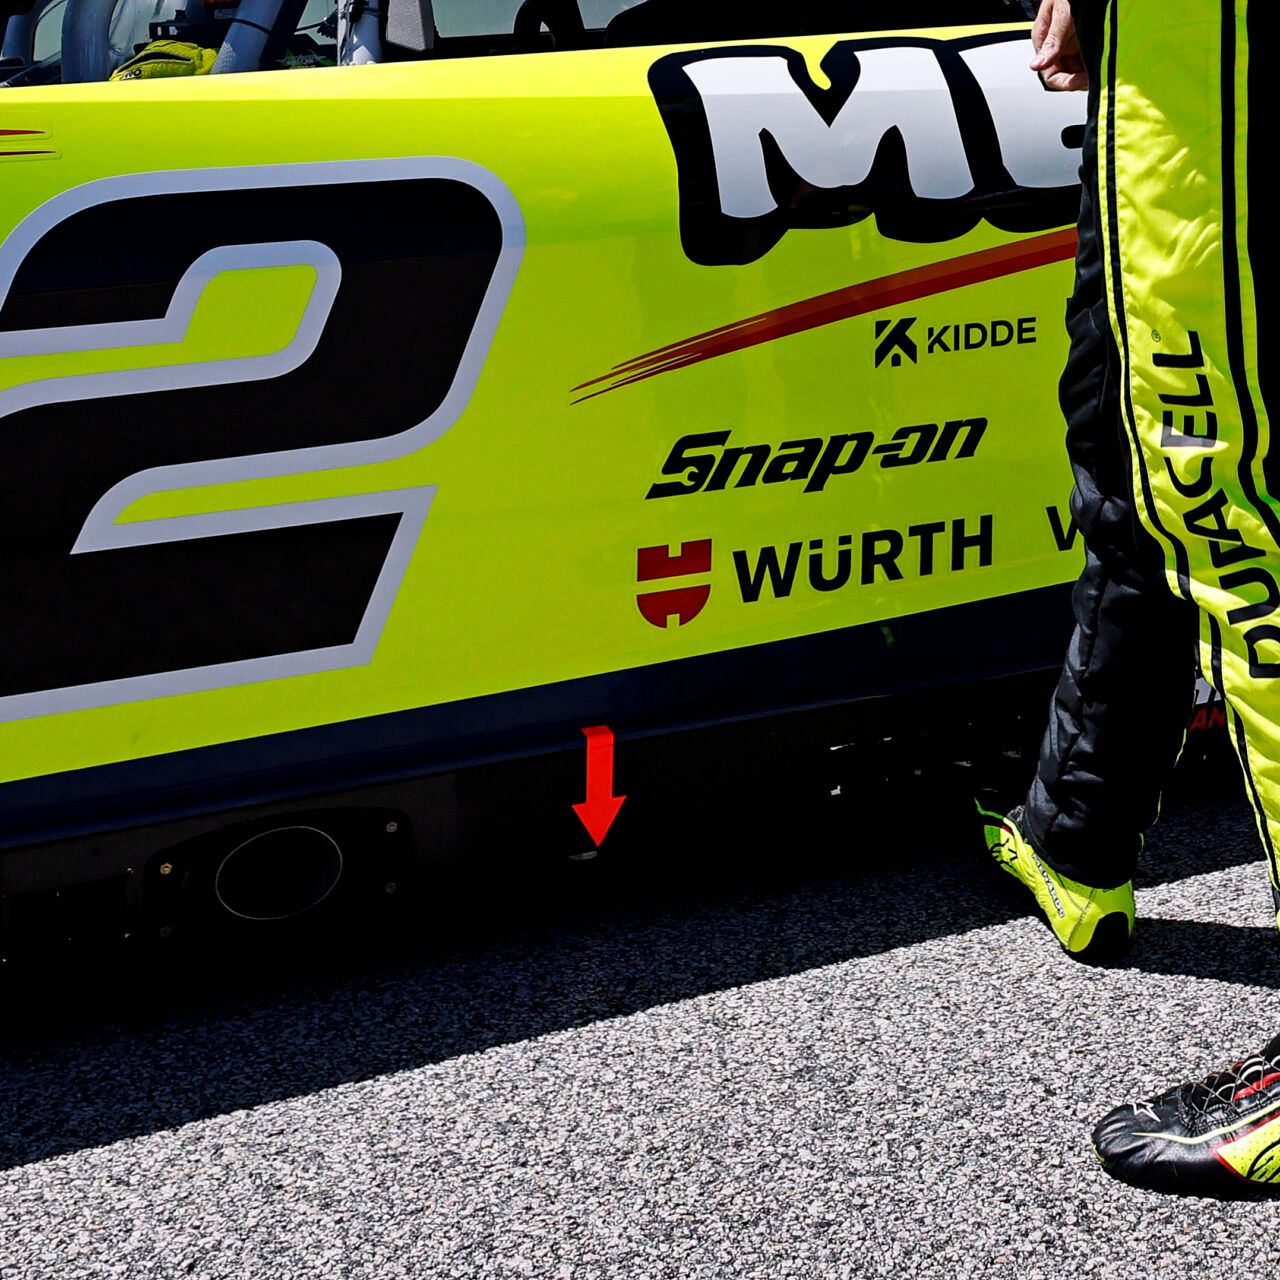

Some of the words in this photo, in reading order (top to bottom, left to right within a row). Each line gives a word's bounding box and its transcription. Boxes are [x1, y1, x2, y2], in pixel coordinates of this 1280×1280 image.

[928, 317, 1037, 354] KIDDE
[645, 417, 989, 500] Snap-on
[732, 514, 994, 604] WÜRTH
